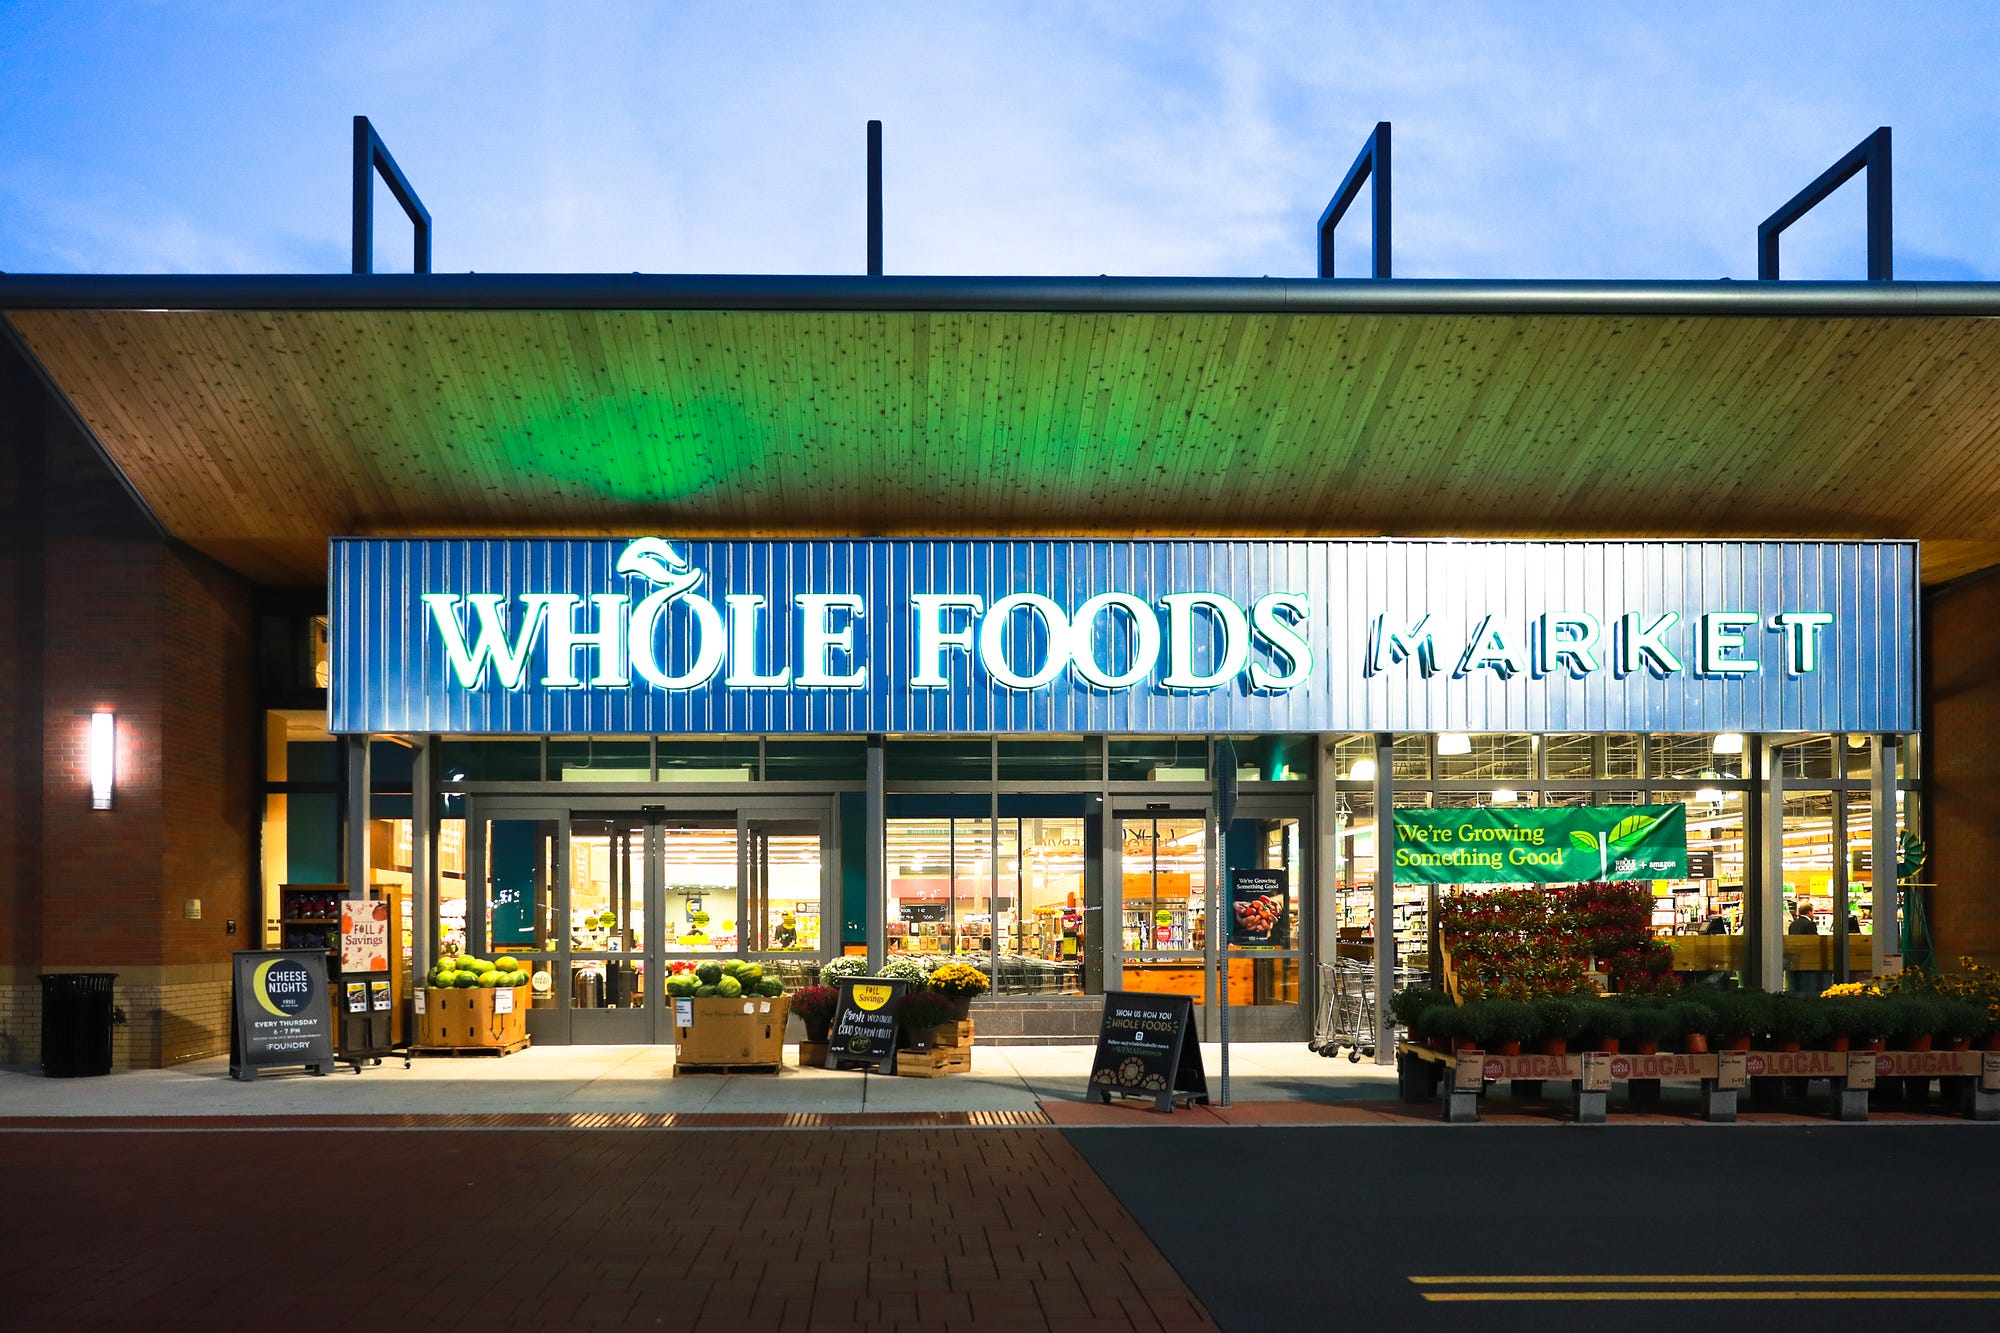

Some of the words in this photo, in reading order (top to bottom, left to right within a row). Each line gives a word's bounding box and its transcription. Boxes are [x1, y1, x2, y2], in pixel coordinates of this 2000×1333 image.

[420, 537, 867, 690] WHOLE
[910, 591, 1314, 692] FOODS
[1368, 610, 1835, 675] MARKET
[1395, 824, 1452, 842] We're
[1458, 824, 1545, 846] Growing
[1396, 848, 1503, 870] Something
[1509, 848, 1564, 866] Good
[1615, 857, 1636, 865] WHOLE
[1649, 861, 1676, 870] amazon
[346, 935, 383, 946] Savings
[268, 971, 307, 982] CHEESE
[268, 982, 308, 992] NIGHTS
[859, 994, 884, 1004] Savings
[1116, 1009, 1132, 1017] SHOW
[1159, 1012, 1172, 1020] YOU
[1112, 1018, 1138, 1029] WHOLE
[1141, 1020, 1172, 1031] FOODS
[269, 1042, 310, 1050] FOUNDRY
[1504, 1056, 1573, 1078] LOCAL
[1631, 1056, 1701, 1077] LOCAL
[1767, 1052, 1834, 1074] LOCAL
[1895, 1053, 1963, 1074] LOCAL
